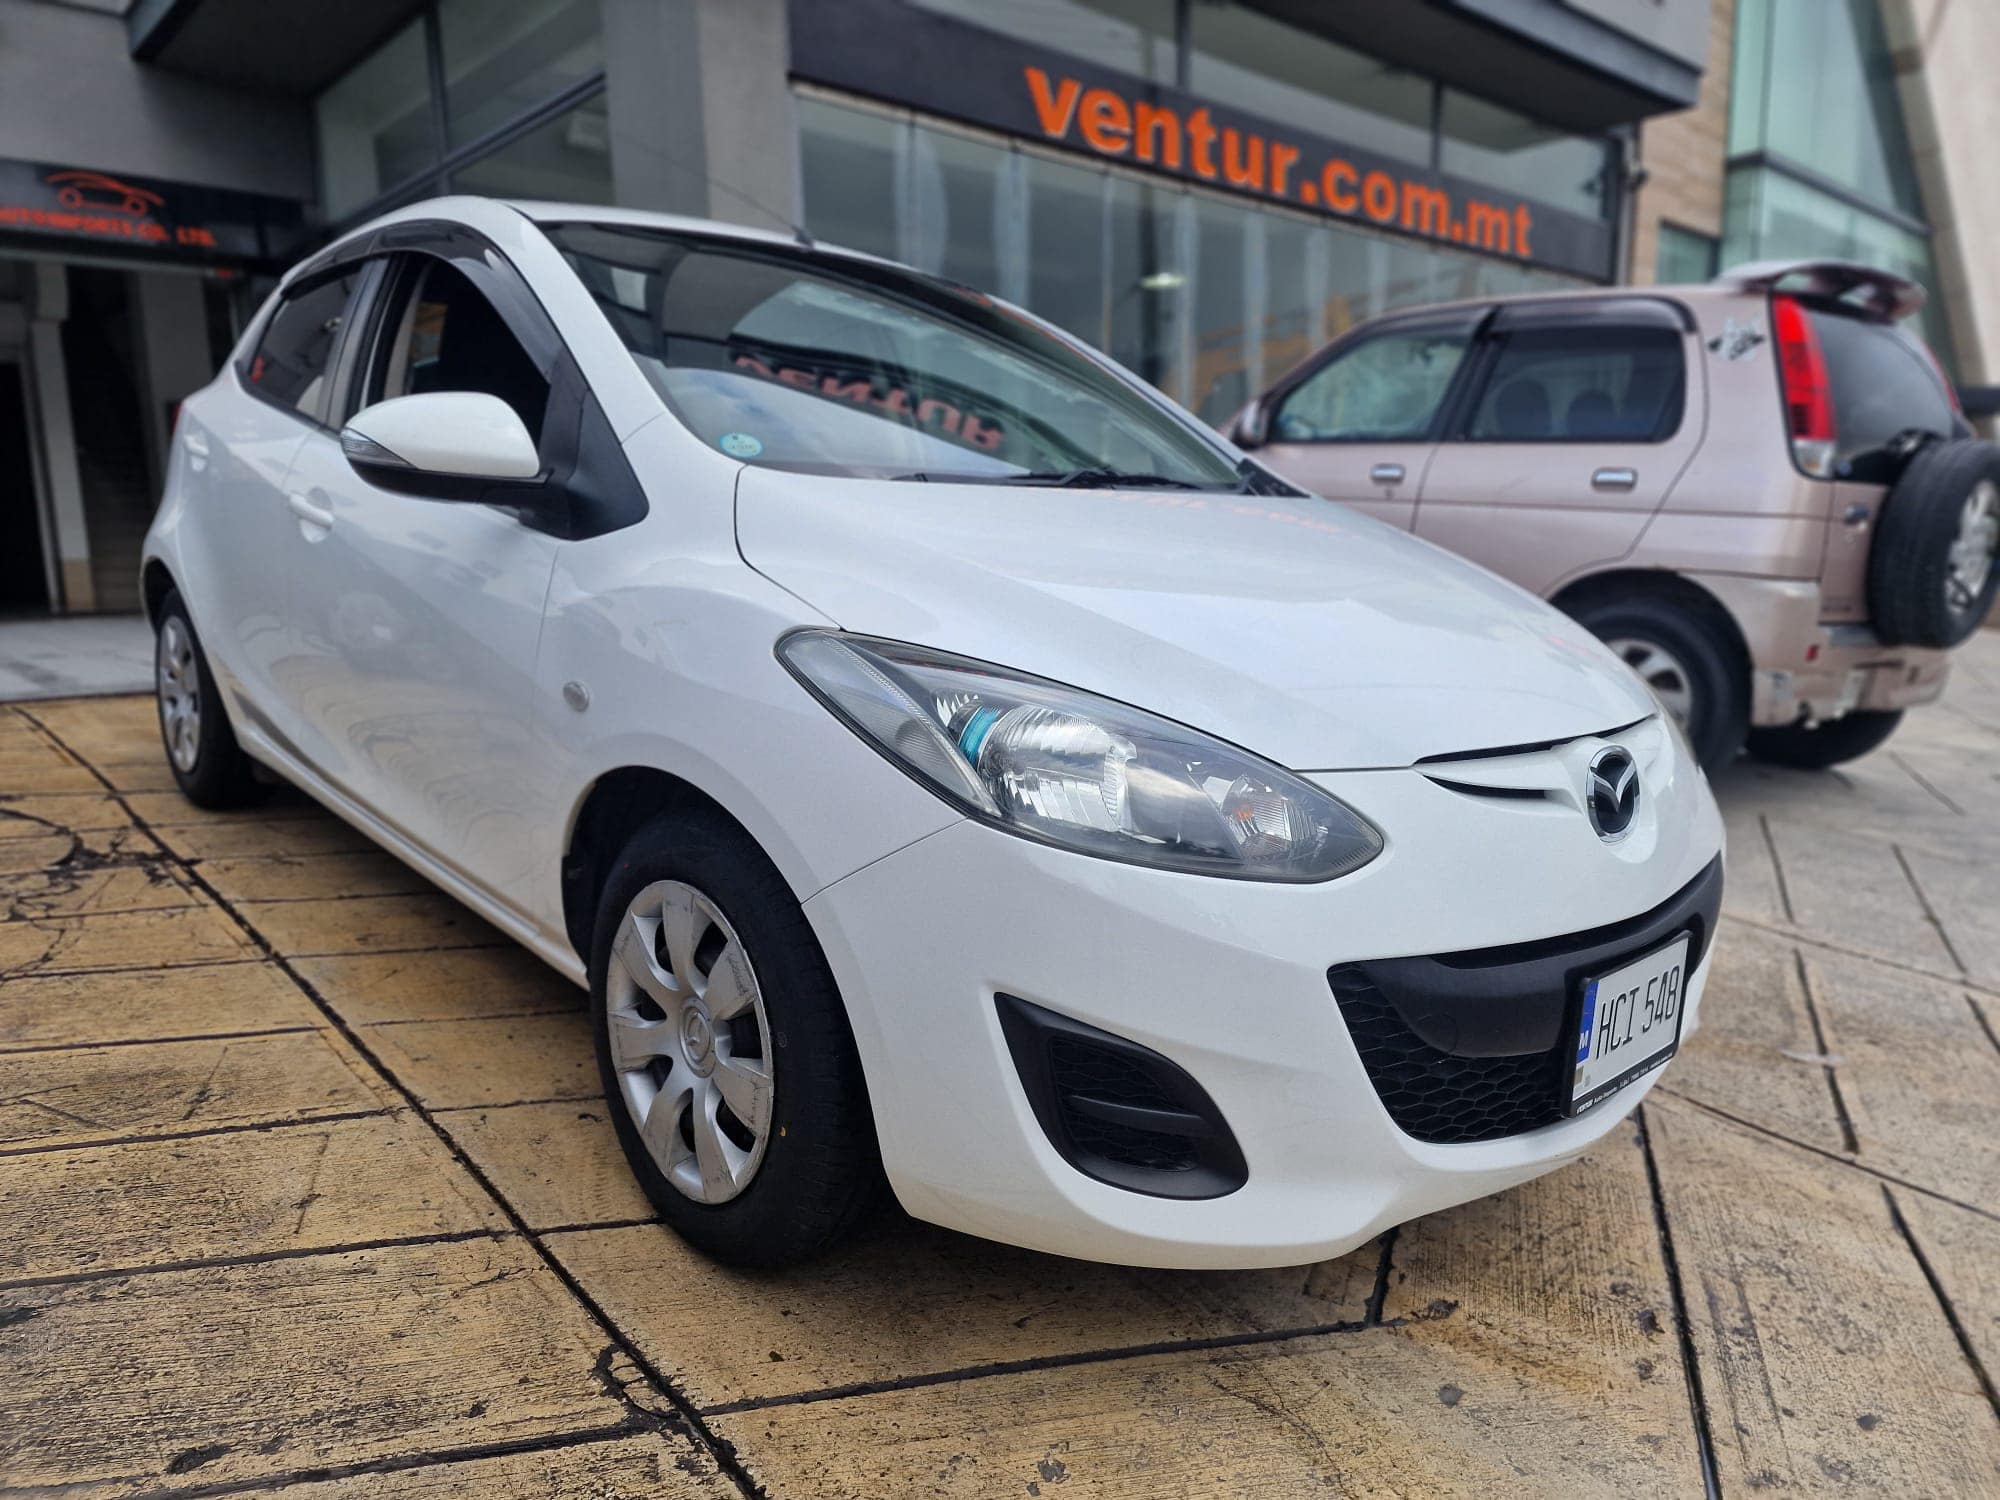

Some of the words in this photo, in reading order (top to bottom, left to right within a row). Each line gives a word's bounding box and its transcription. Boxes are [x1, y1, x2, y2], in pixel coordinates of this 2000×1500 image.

[1024, 66, 1534, 258] ventur.com.mt
[1578, 1030, 1589, 1050] M
[1596, 986, 1640, 1060] HCI
[1642, 965, 1680, 1034] 548
